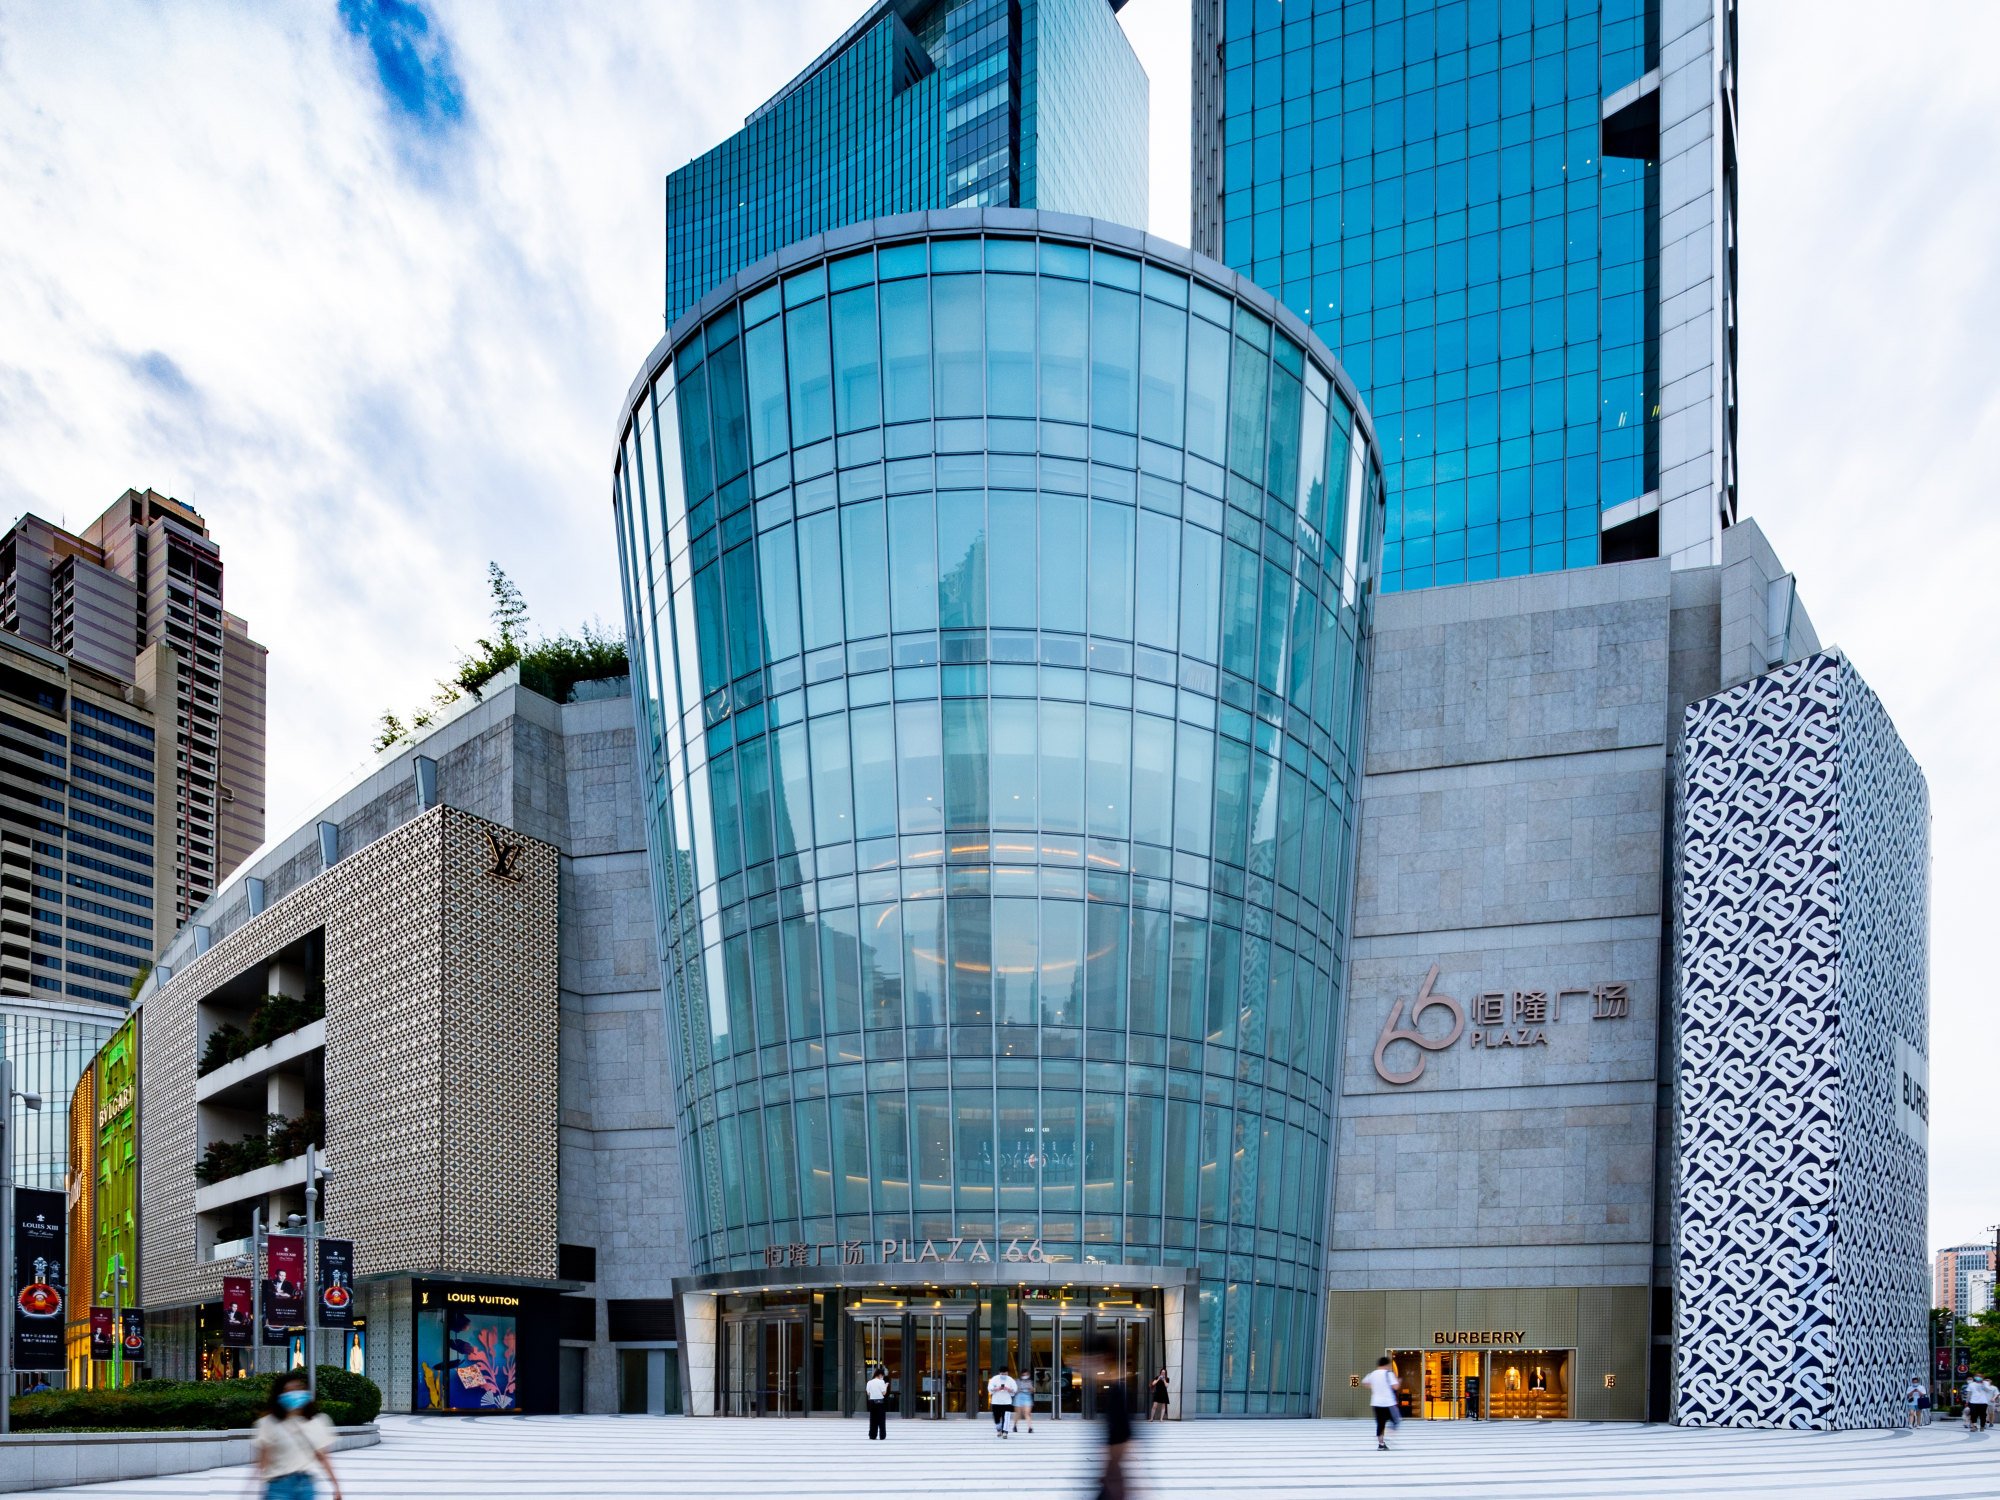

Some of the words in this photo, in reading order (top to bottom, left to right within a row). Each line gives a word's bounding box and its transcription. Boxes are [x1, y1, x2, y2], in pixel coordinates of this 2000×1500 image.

[1471, 983, 1629, 1026] 恒隆广场
[1471, 1028, 1548, 1049] PLAZA
[99, 1084, 134, 1128] BVLGARI
[22, 1221, 45, 1229] LOUIS
[764, 1239, 865, 1268] 恒隆广场
[882, 1238, 991, 1264] PLAZA
[1006, 1238, 1044, 1263] 66
[447, 1292, 476, 1303] LOUIS
[478, 1295, 519, 1306] VUITTON
[1433, 1331, 1526, 1344] BURBERRY
